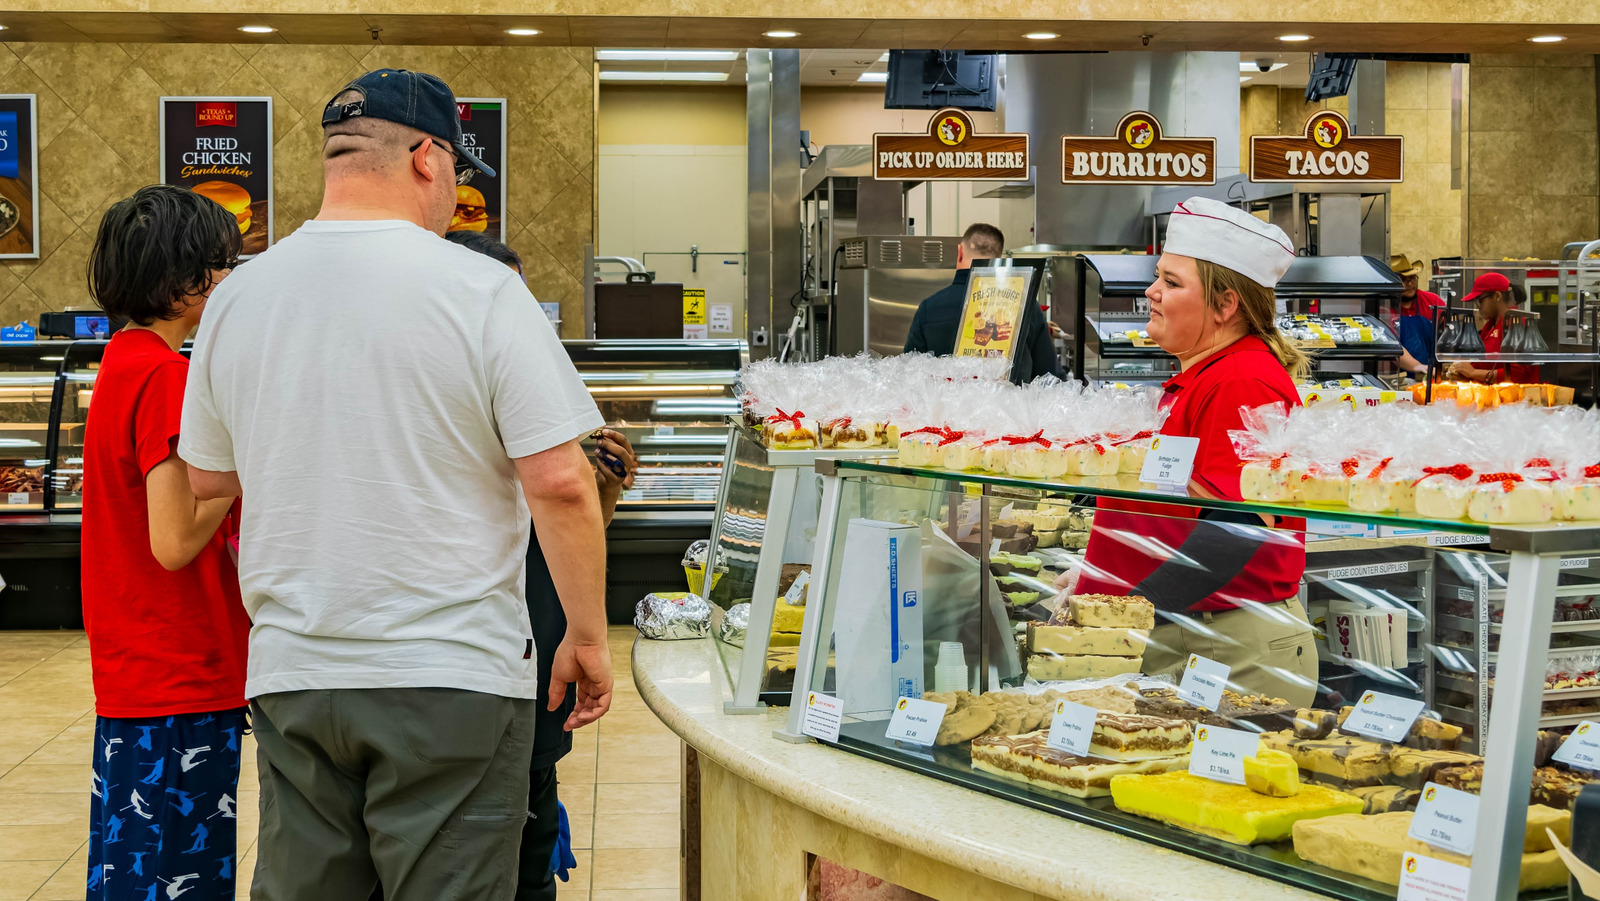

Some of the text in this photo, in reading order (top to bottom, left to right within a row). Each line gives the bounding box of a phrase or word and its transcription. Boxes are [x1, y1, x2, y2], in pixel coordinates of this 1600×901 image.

[196, 137, 238, 150] FRIED
[182, 152, 252, 165] CHICKEN
[880, 151, 1024, 168] PICK UP ORDER HERE
[1072, 152, 1207, 177] BURRITOS
[1285, 151, 1370, 175] TACOS
[181, 165, 253, 178] Sandwiches
[972, 288, 1020, 302] FRESH FUDGE
[1435, 535, 1485, 544] FUDGE BOXES
[1329, 563, 1408, 578] FUDGE COUNTER SUPPLIES
[1386, 714, 1406, 722] Chocolate
[1210, 765, 1230, 775] $3.78/ea.
[1434, 810, 1462, 824] Peanut Butter
